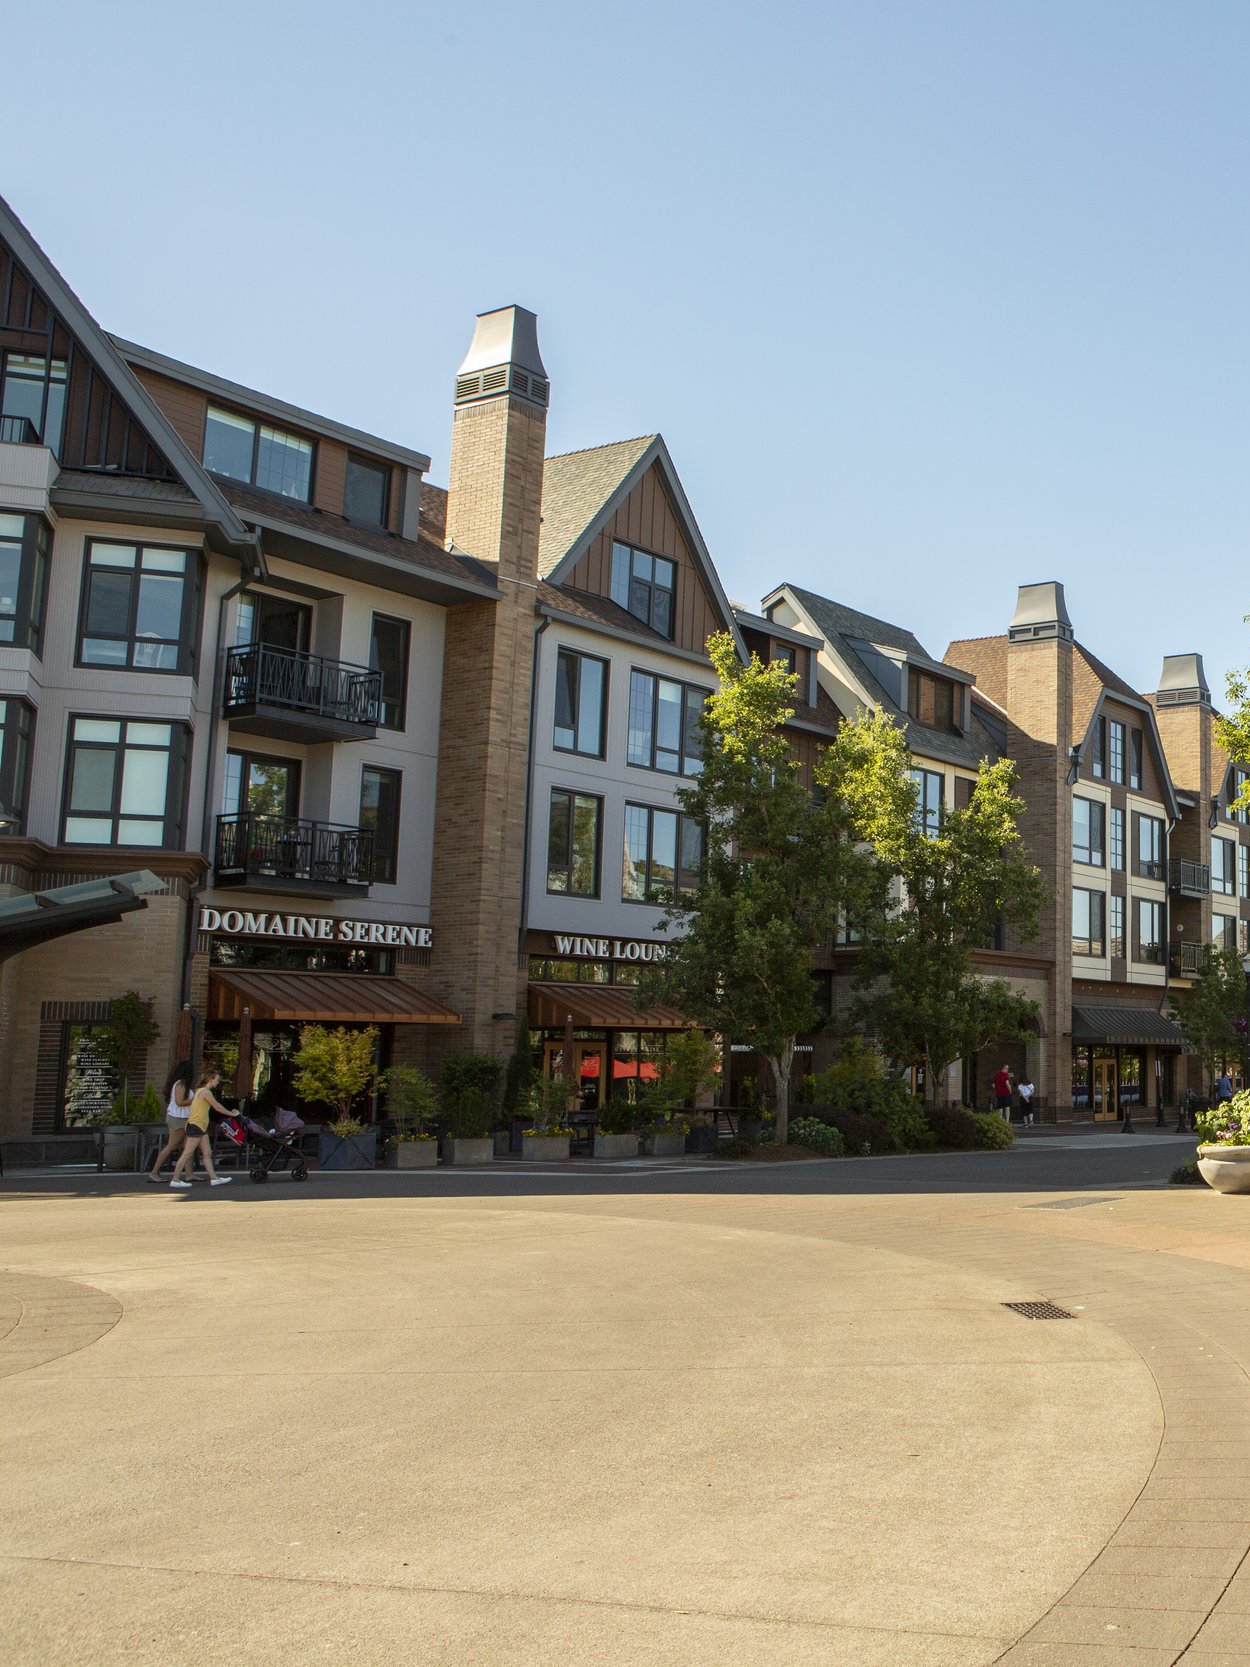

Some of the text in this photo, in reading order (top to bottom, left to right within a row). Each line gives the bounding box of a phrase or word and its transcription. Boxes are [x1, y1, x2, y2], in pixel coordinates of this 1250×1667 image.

[199, 908, 433, 948] DOMAINE SERENE
[554, 935, 690, 963] WINE LOUN
